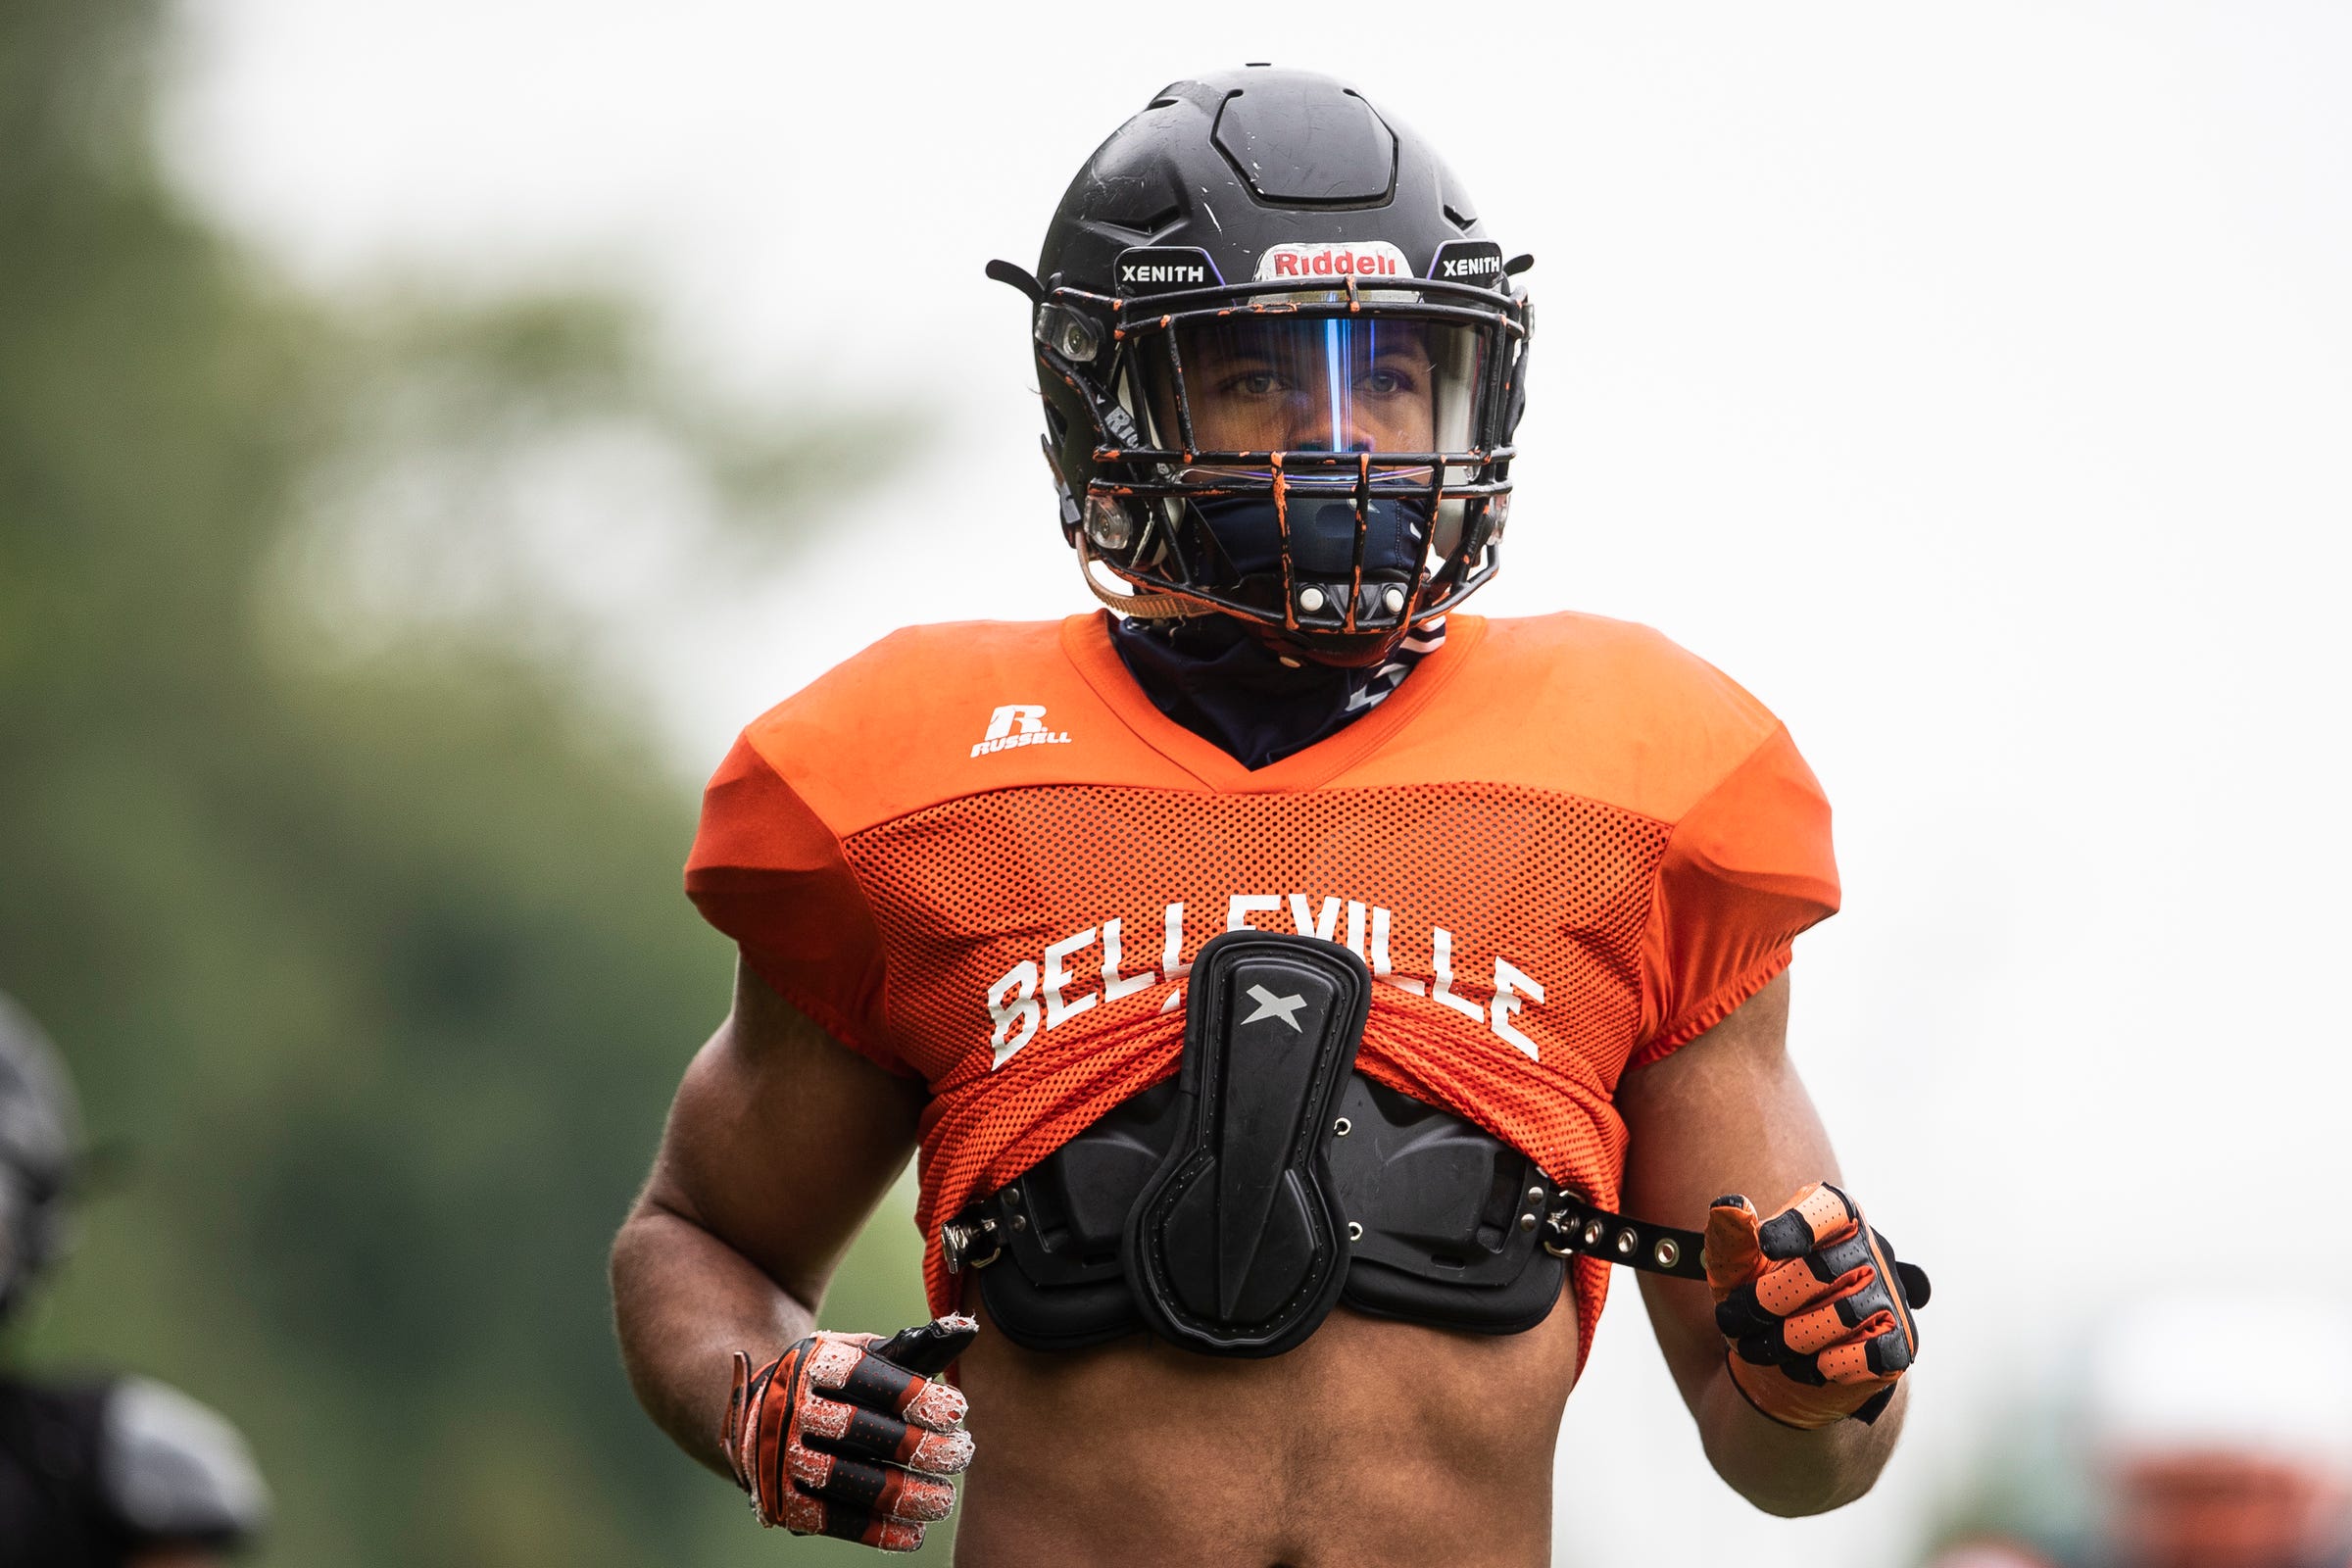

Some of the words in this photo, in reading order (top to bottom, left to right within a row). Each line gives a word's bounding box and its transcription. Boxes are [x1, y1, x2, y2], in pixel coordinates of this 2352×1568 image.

[1274, 250, 1396, 275] Riddell
[1443, 256, 1500, 277] XENITH
[1121, 266, 1204, 283] XENITH
[970, 732, 1072, 759] RUSSELL
